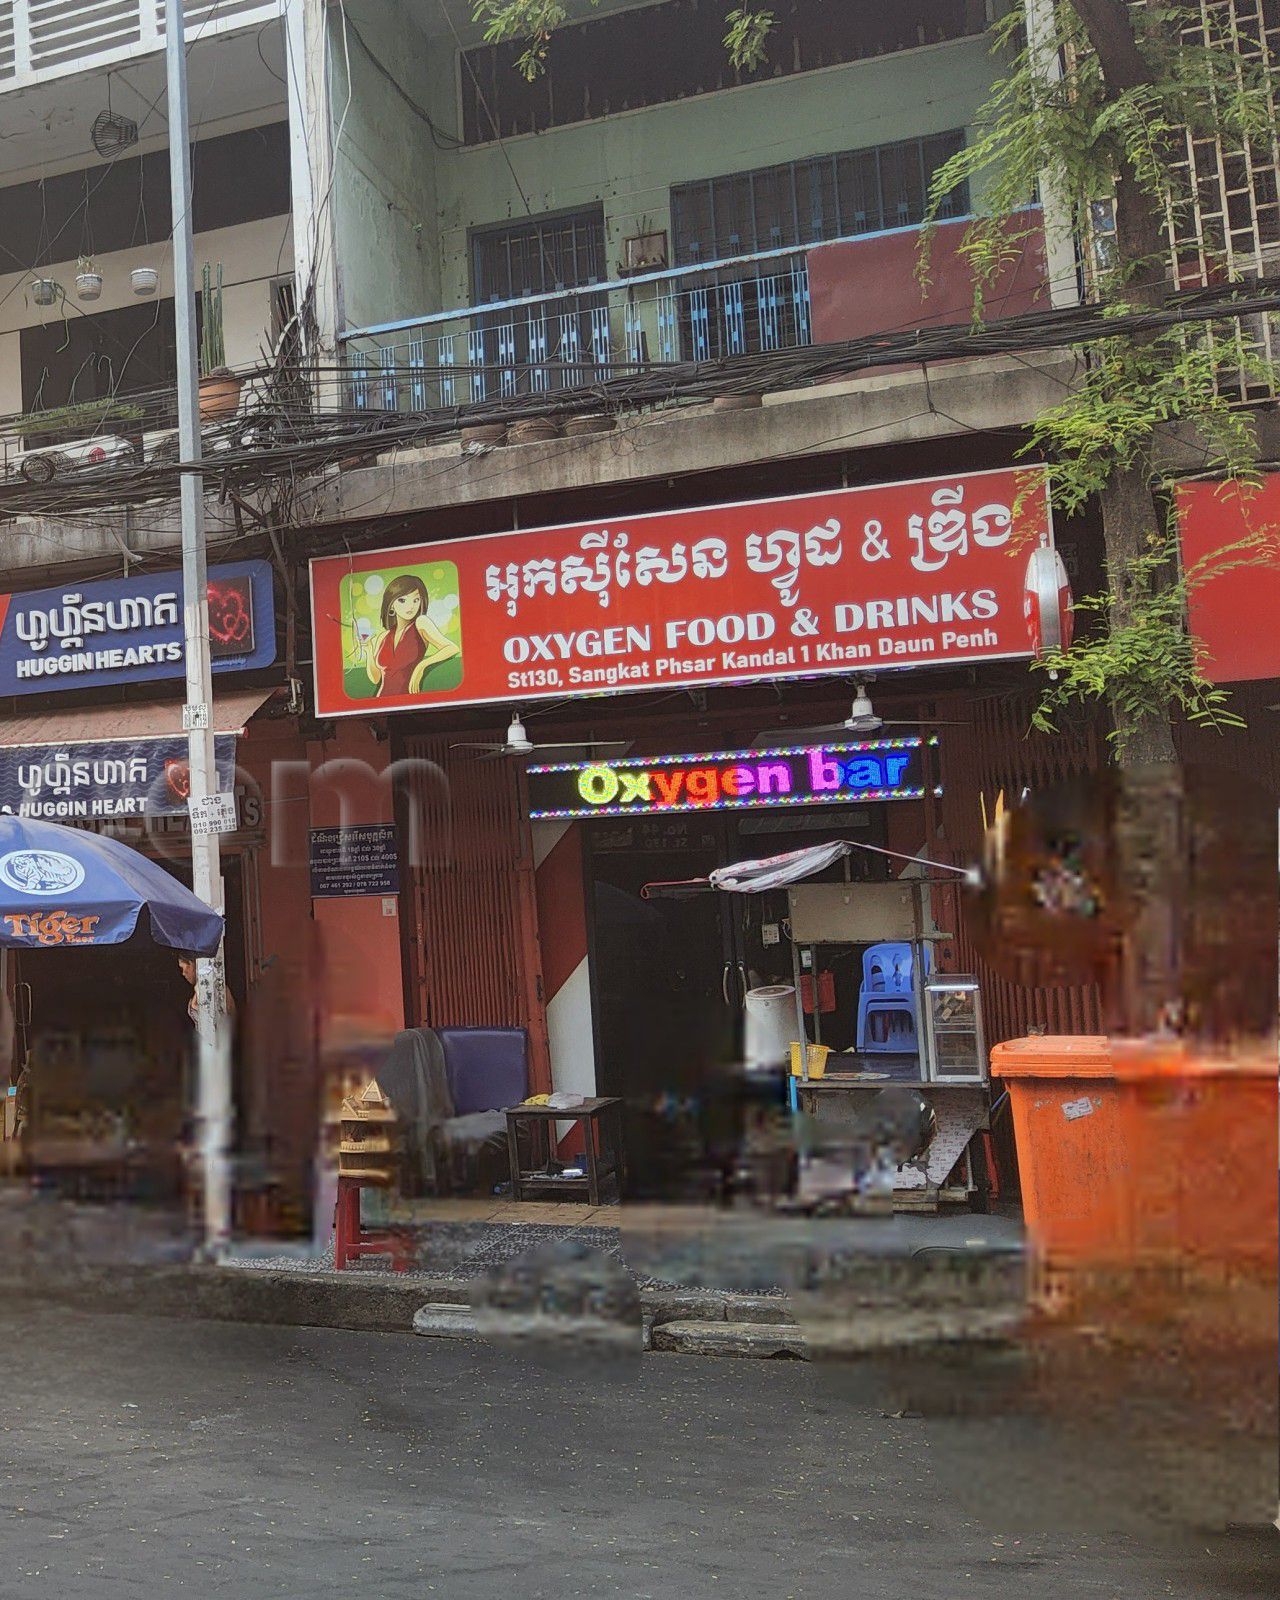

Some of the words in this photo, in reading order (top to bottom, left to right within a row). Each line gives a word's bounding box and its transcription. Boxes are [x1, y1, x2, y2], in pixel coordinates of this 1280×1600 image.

[861, 519, 891, 562] &
[503, 624, 651, 665] OXYGEN
[666, 612, 776, 650] FOOD
[790, 607, 820, 638] &
[834, 589, 1000, 634] DRINKS
[16, 651, 95, 679] HUGGIN
[95, 641, 183, 669] HEARTS
[507, 668, 564, 690] St130,
[568, 659, 650, 686] Sangkat
[656, 652, 716, 677] Phsar
[722, 646, 795, 670] Kandal
[800, 646, 810, 663] 1
[816, 642, 872, 662] Khan
[878, 636, 934, 657] Daun
[942, 628, 998, 650] Penh
[577, 761, 792, 807] Oxygen
[808, 751, 909, 791] bar
[19, 801, 87, 818] HUGGIN
[91, 797, 149, 815] HEART
[4, 910, 100, 946] Tiger
